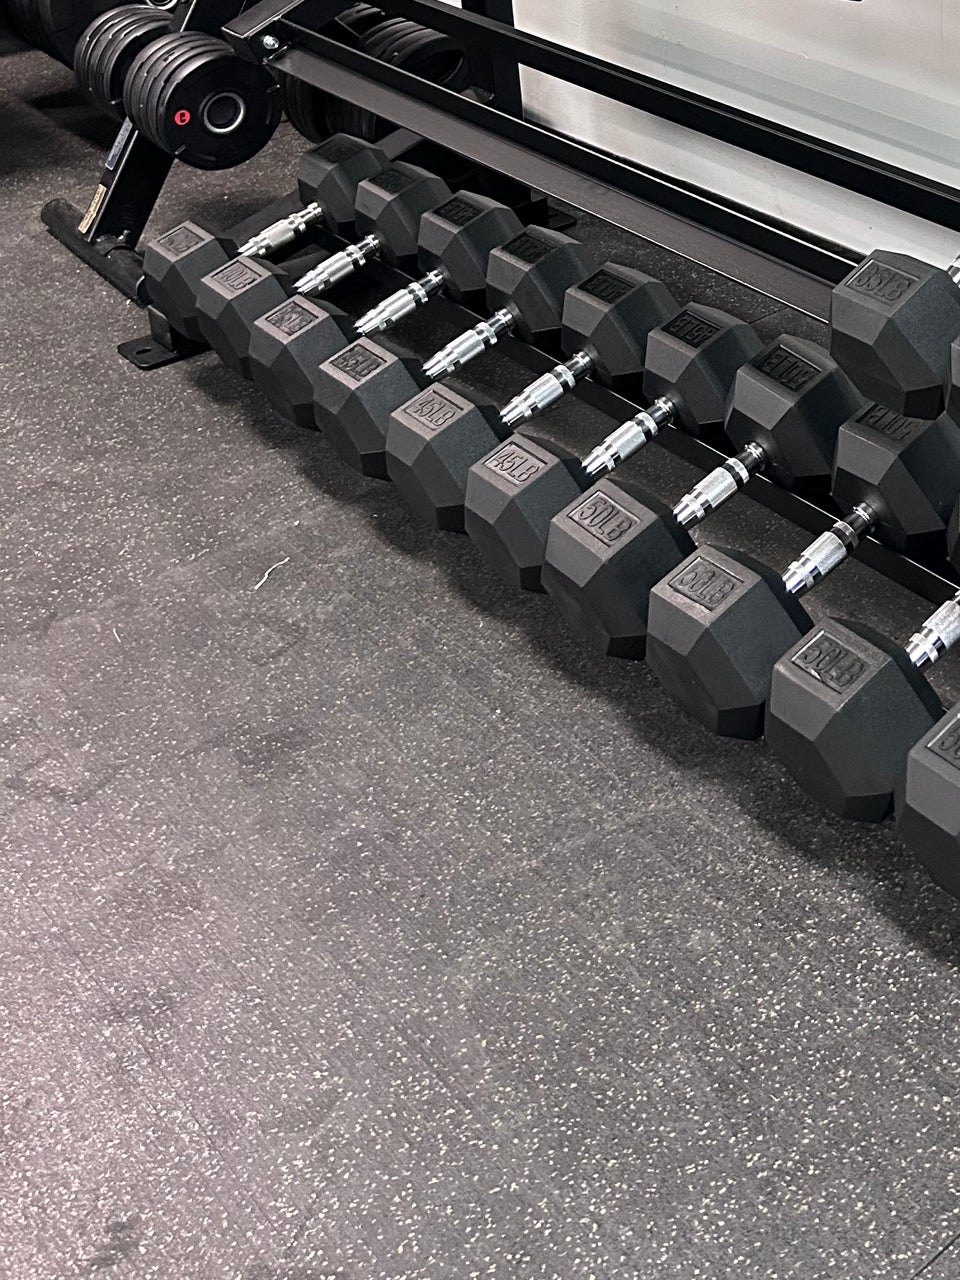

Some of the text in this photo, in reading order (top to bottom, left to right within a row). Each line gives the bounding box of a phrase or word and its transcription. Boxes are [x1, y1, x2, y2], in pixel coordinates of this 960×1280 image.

[414, 396, 457, 427] 45LB
[493, 444, 541, 483] 45LB
[579, 499, 633, 543] 50LB
[679, 563, 736, 607] 50LB
[803, 637, 866, 689] 50LB
